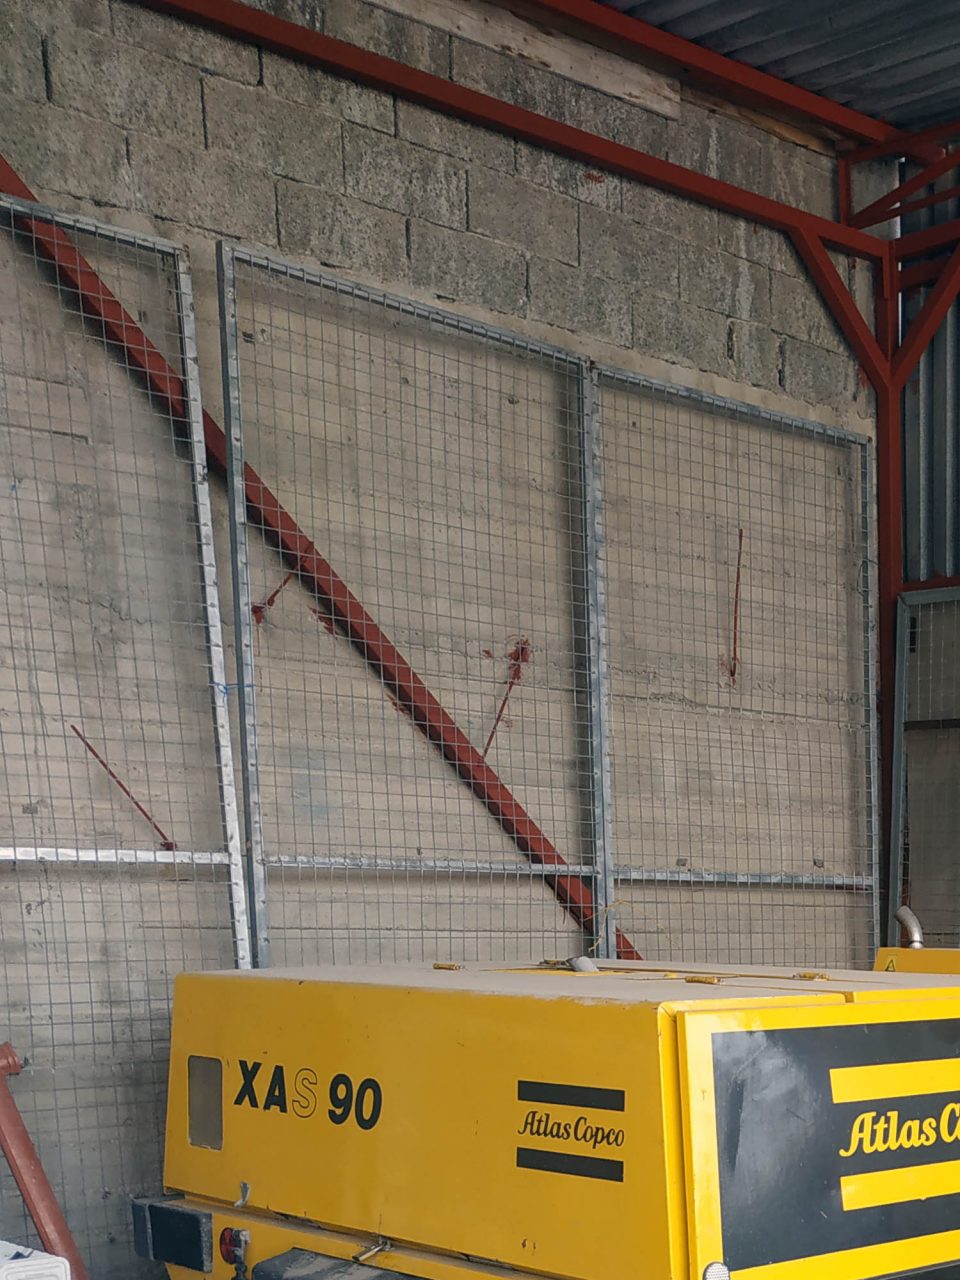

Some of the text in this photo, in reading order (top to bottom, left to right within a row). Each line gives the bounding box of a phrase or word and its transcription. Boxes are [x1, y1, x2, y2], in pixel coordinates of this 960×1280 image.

[233, 1059, 382, 1130] XAS 90
[517, 1110, 625, 1149] Atlas Copco
[839, 1111, 937, 1157] Atlas
